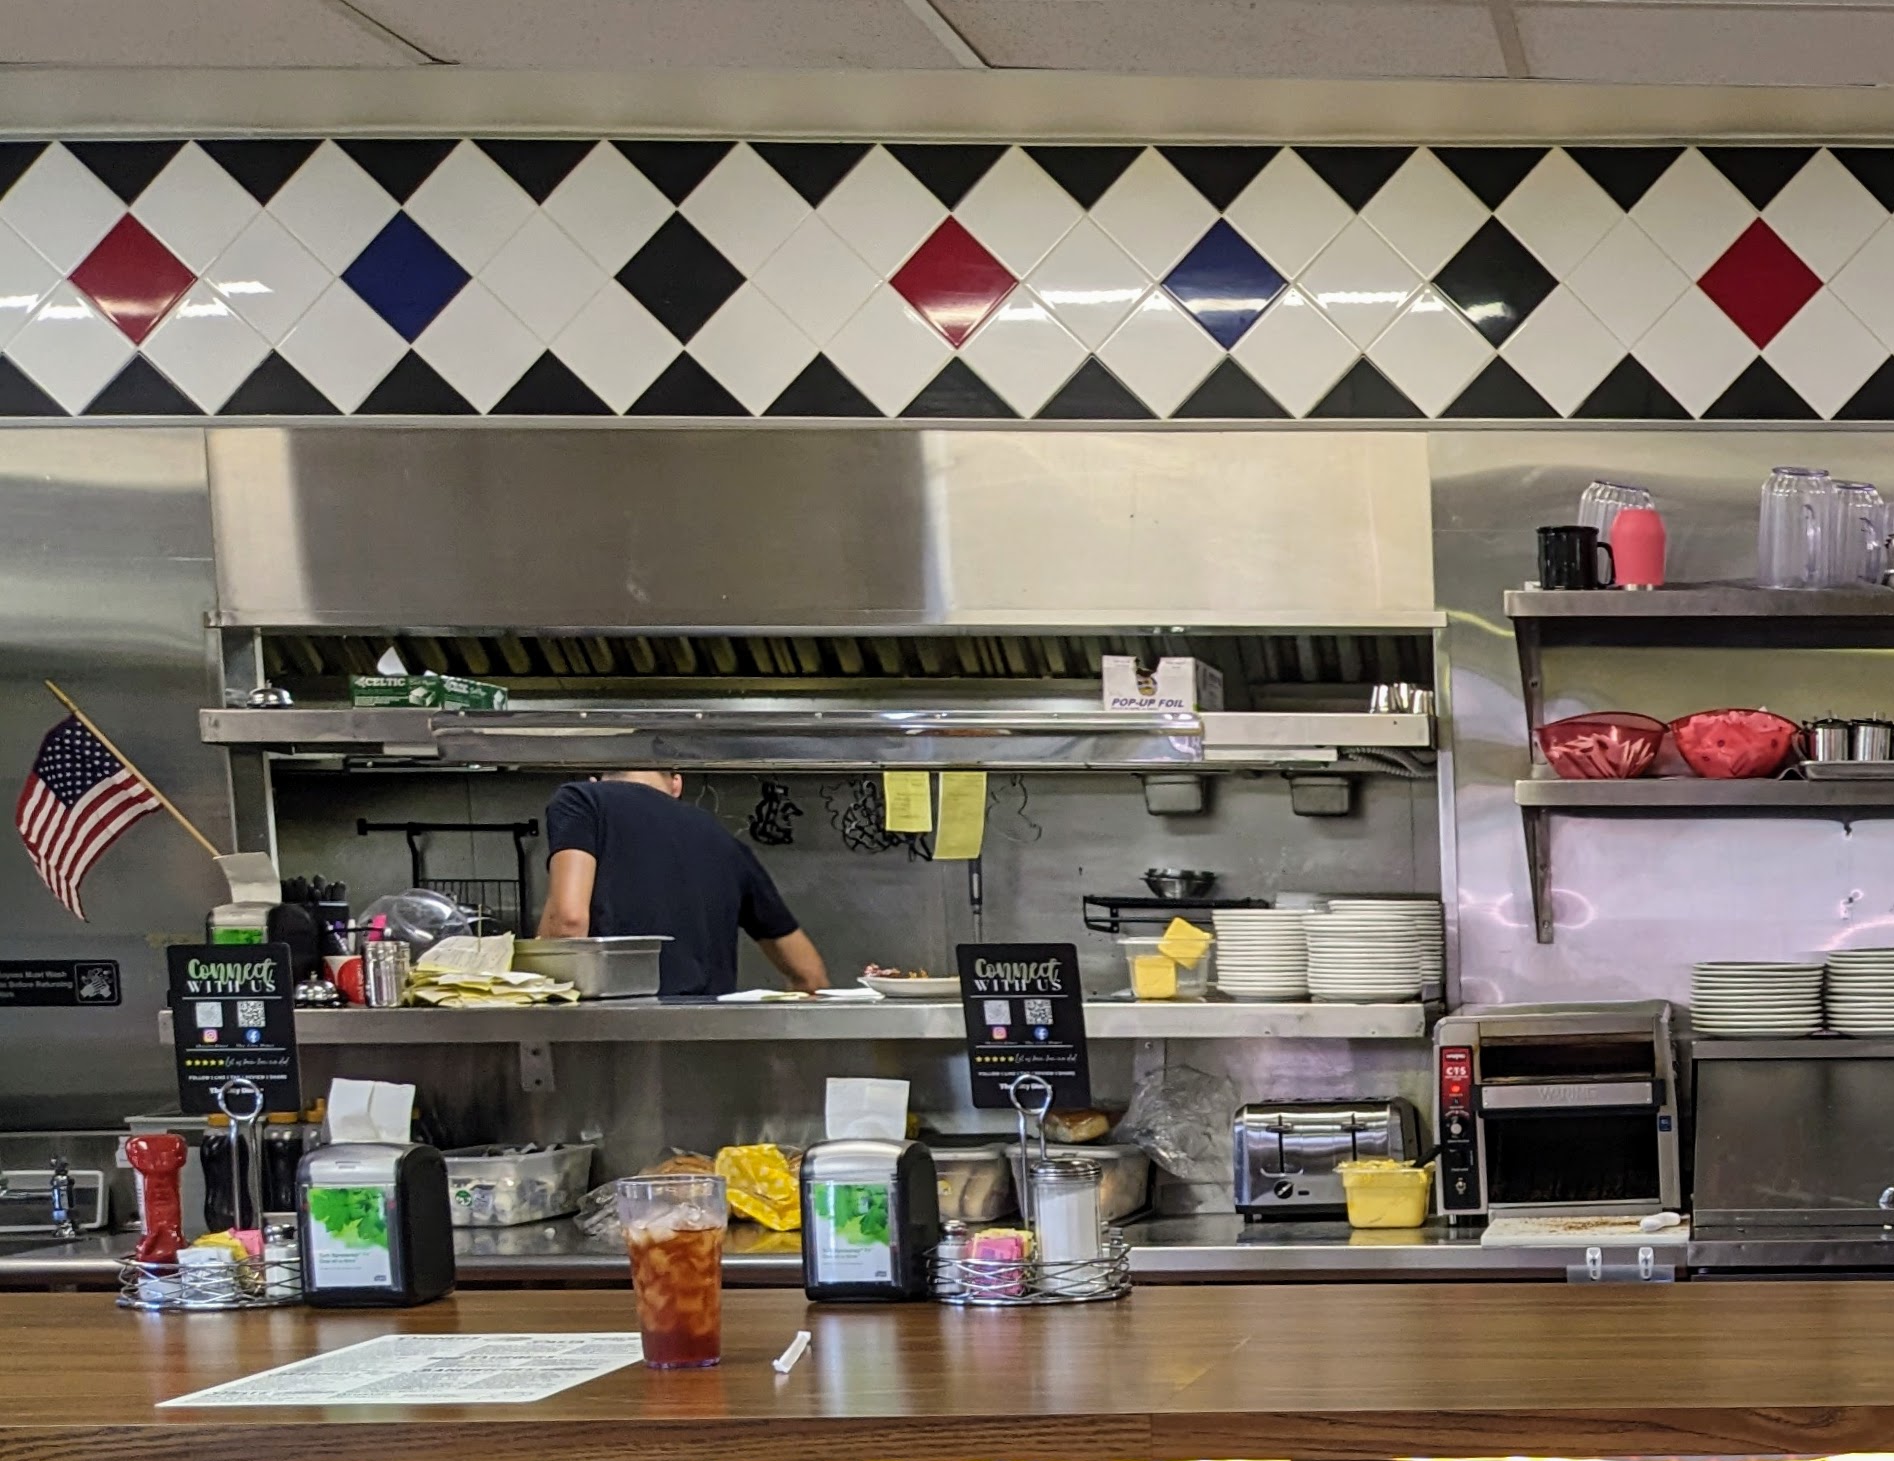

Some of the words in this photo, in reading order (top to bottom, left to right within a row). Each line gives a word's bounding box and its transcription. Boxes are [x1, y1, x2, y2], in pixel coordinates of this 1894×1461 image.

[1111, 697, 1156, 708] POP-UP
[1158, 698, 1185, 708] FOIL
[187, 957, 278, 985] Connect
[974, 957, 1063, 984] Connect
[187, 980, 240, 993] WITH
[250, 979, 276, 993] US
[973, 978, 1027, 992] WITH
[1036, 978, 1062, 992] US
[1445, 1066, 1467, 1076] CTS
